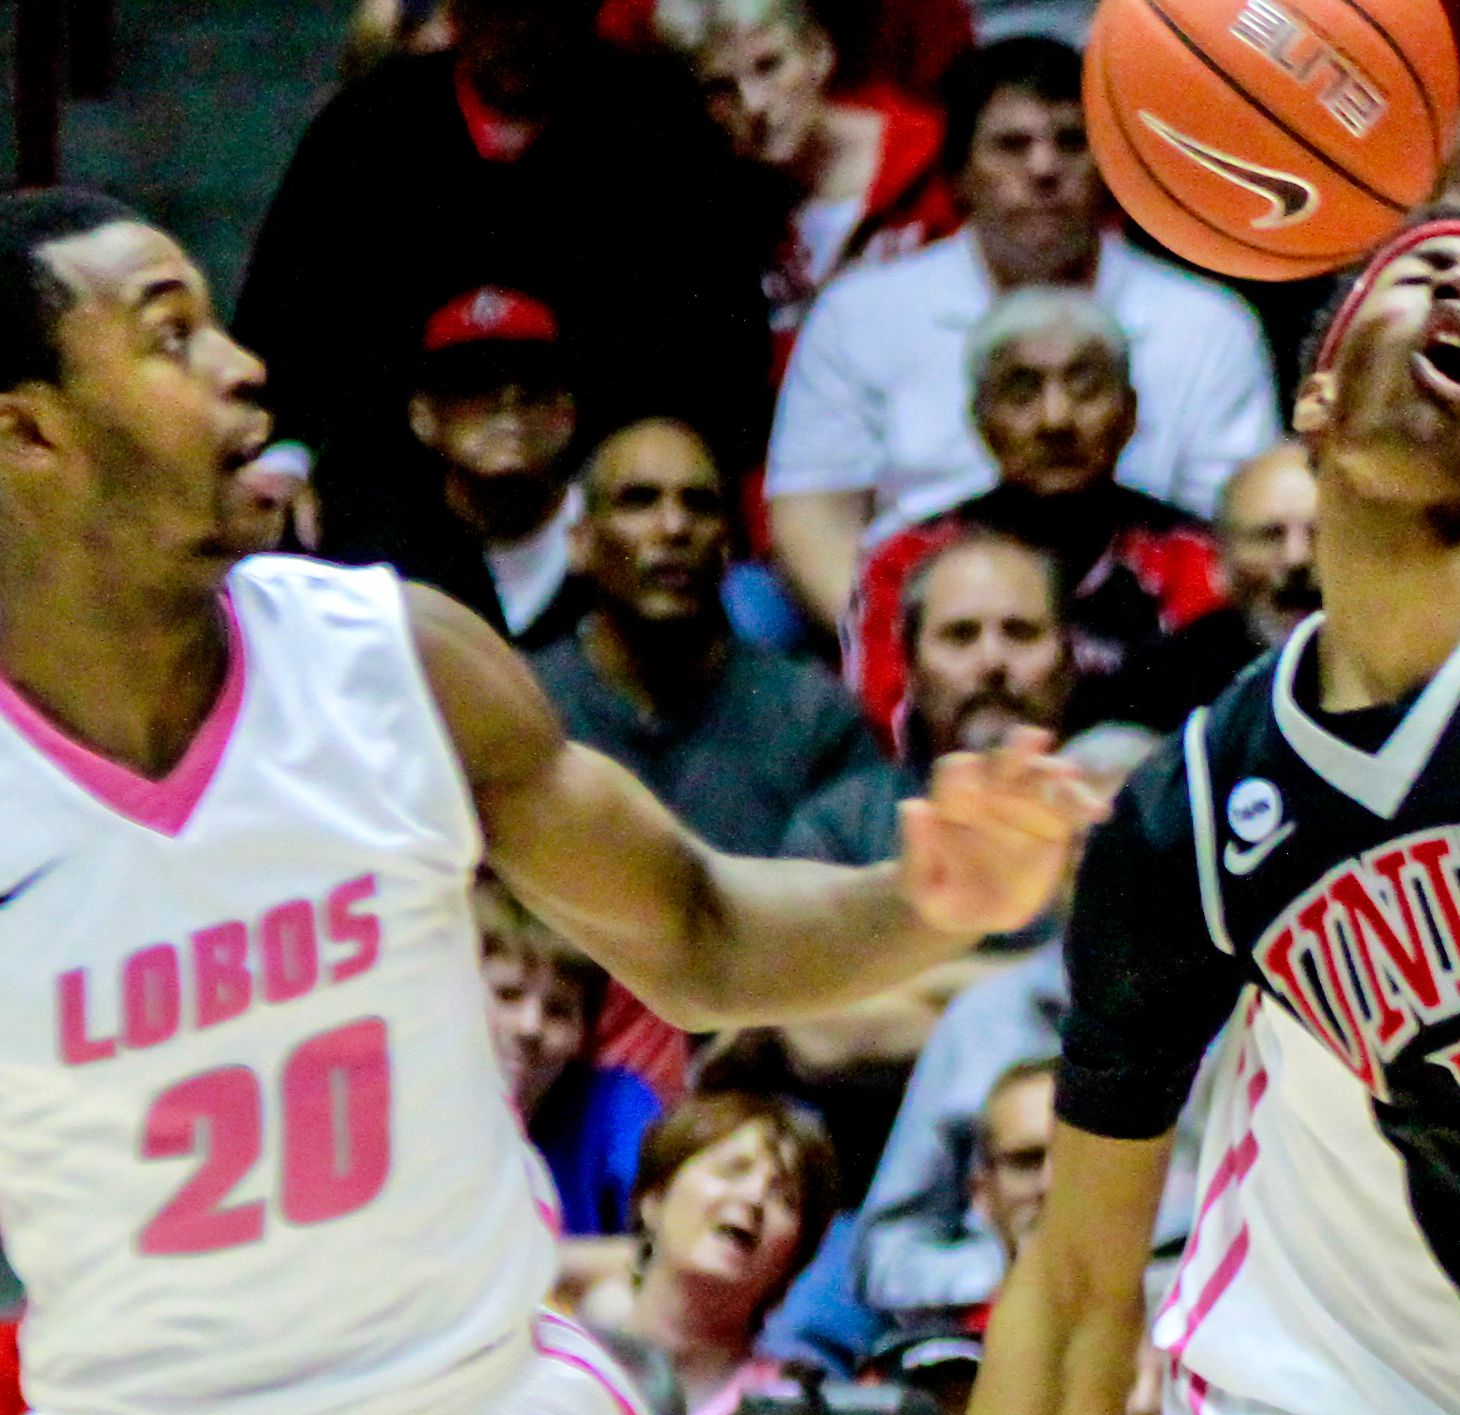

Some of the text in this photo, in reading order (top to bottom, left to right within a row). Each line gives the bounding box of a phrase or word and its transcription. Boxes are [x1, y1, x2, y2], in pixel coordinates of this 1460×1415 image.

[1229, 0, 1390, 139] ELITE
[56, 872, 381, 1066] LOBOS
[136, 1015, 393, 1256] 20
